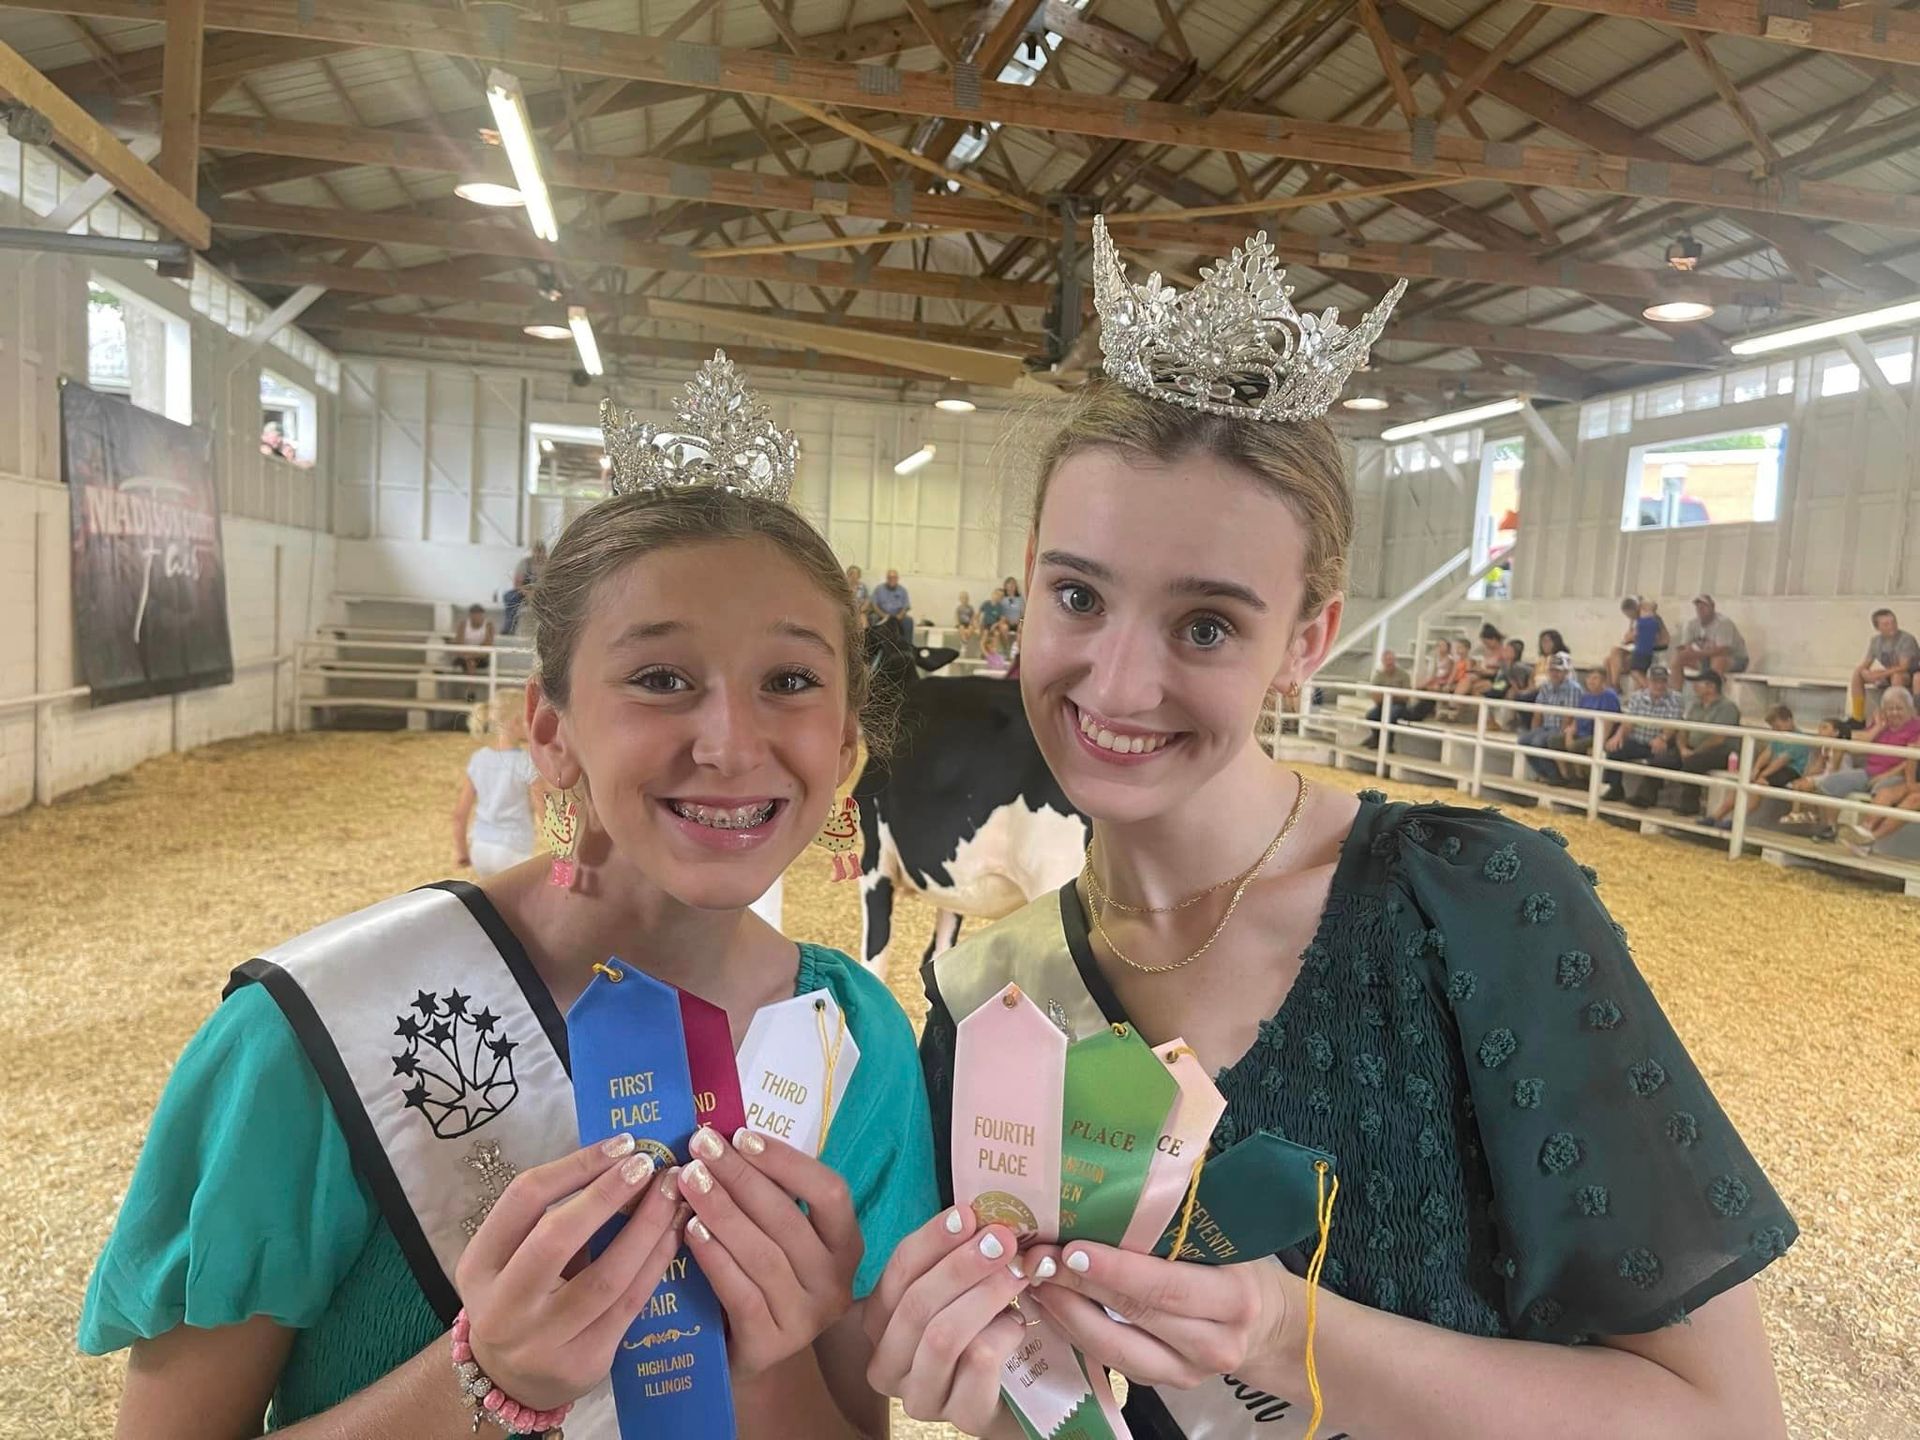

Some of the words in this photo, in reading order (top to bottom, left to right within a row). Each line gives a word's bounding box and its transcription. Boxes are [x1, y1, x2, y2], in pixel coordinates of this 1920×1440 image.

[609, 1071, 654, 1099] FIRST
[761, 1070, 808, 1105] THIRD
[611, 1100, 662, 1130] PLACE
[746, 1102, 796, 1139] PLACE
[974, 1115, 1036, 1147] FOURTH
[1070, 1119, 1136, 1152] PLACE
[978, 1148, 1028, 1177] PLACE
[637, 1352, 695, 1377] HIGHLAND
[1005, 1338, 1043, 1374] HIGHLAND
[644, 1376, 693, 1398] ILLINOIS
[1020, 1358, 1049, 1389] ILLINOIS
